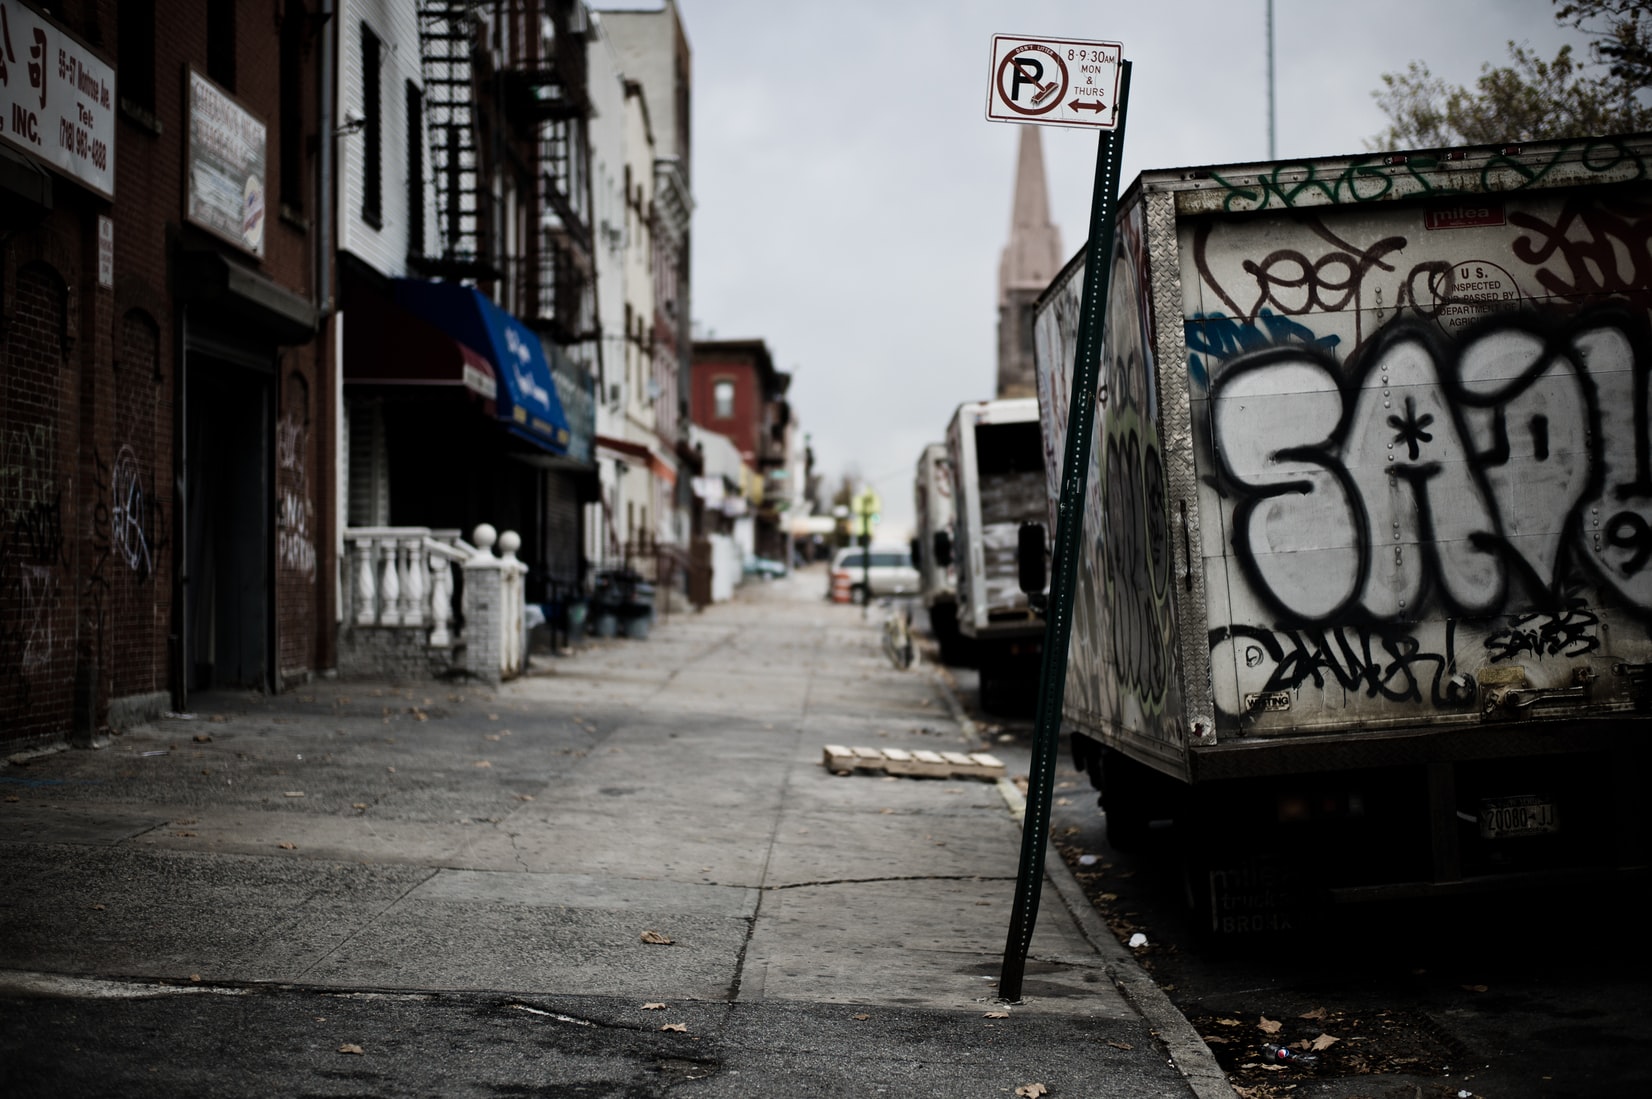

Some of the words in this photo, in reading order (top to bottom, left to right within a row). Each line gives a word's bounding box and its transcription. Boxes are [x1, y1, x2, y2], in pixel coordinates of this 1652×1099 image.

[1081, 64, 1101, 74] MON
[58, 48, 76, 86] 55-57
[78, 60, 103, 104] Montrose
[1086, 76, 1093, 85] &
[1074, 86, 1105, 97] THURS
[77, 101, 93, 130] Tel:
[12, 102, 42, 146] INC.
[59, 115, 75, 154] (718)
[1433, 205, 1489, 227] milea
[1451, 281, 1501, 293] INSPECTED
[1464, 293, 1499, 302] PASSED
[1503, 291, 1514, 300] BY
[1440, 303, 1499, 316] DEPARTMENT
